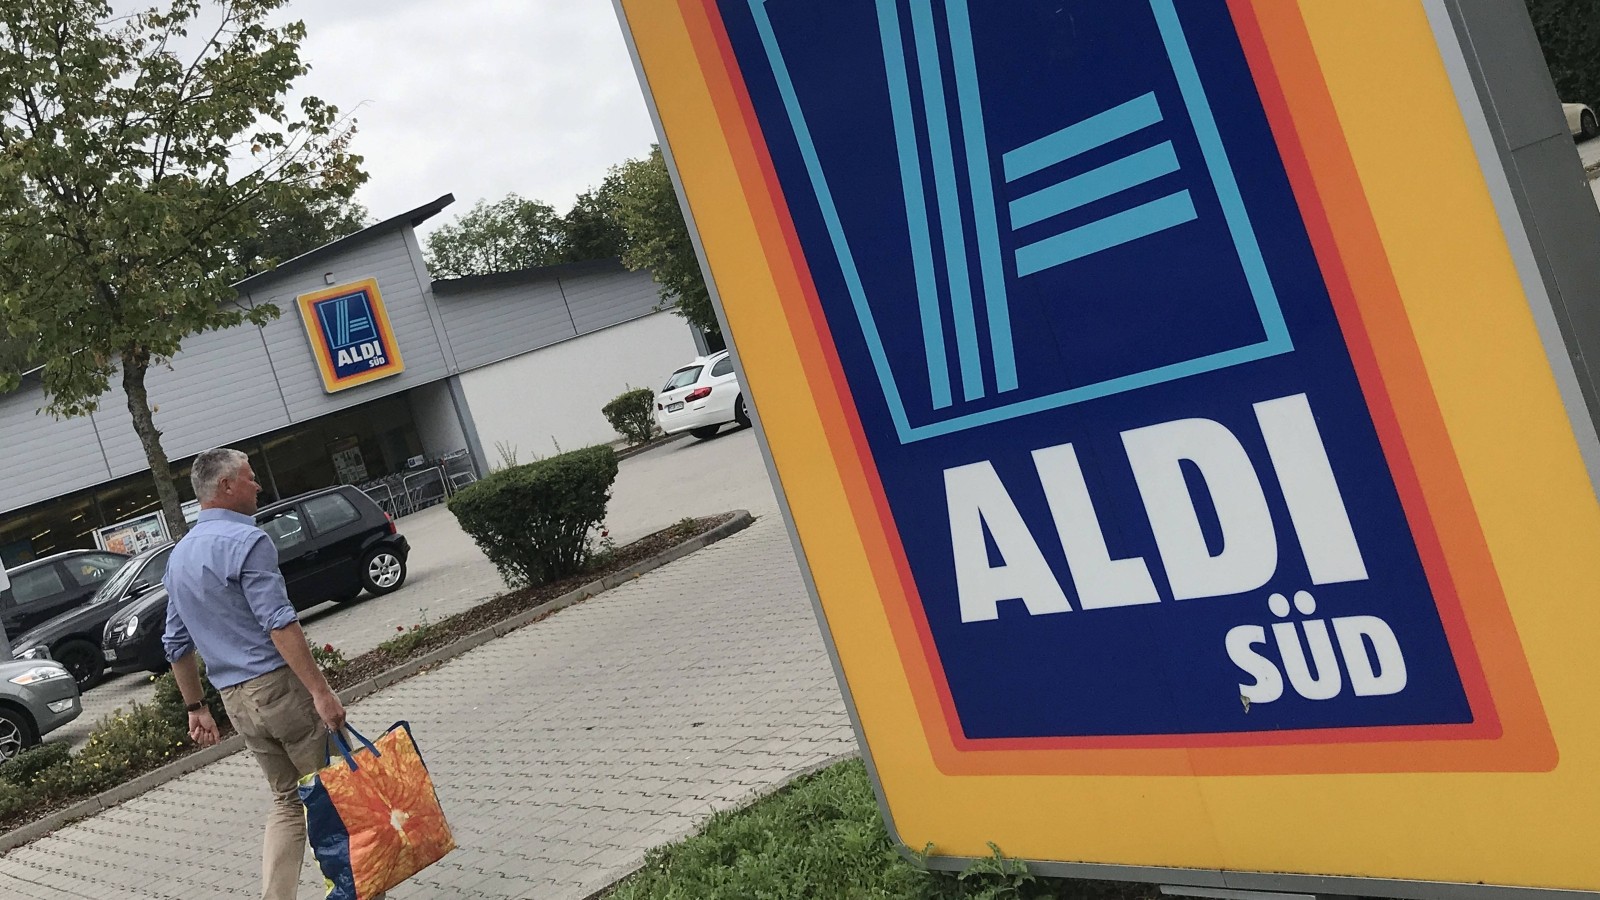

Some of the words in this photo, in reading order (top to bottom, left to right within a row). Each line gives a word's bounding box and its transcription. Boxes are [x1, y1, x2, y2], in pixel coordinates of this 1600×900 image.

[338, 340, 382, 367] ALDI
[368, 356, 385, 367] SÜD
[943, 392, 1369, 623] ALDI
[1225, 590, 1408, 704] SÜD
